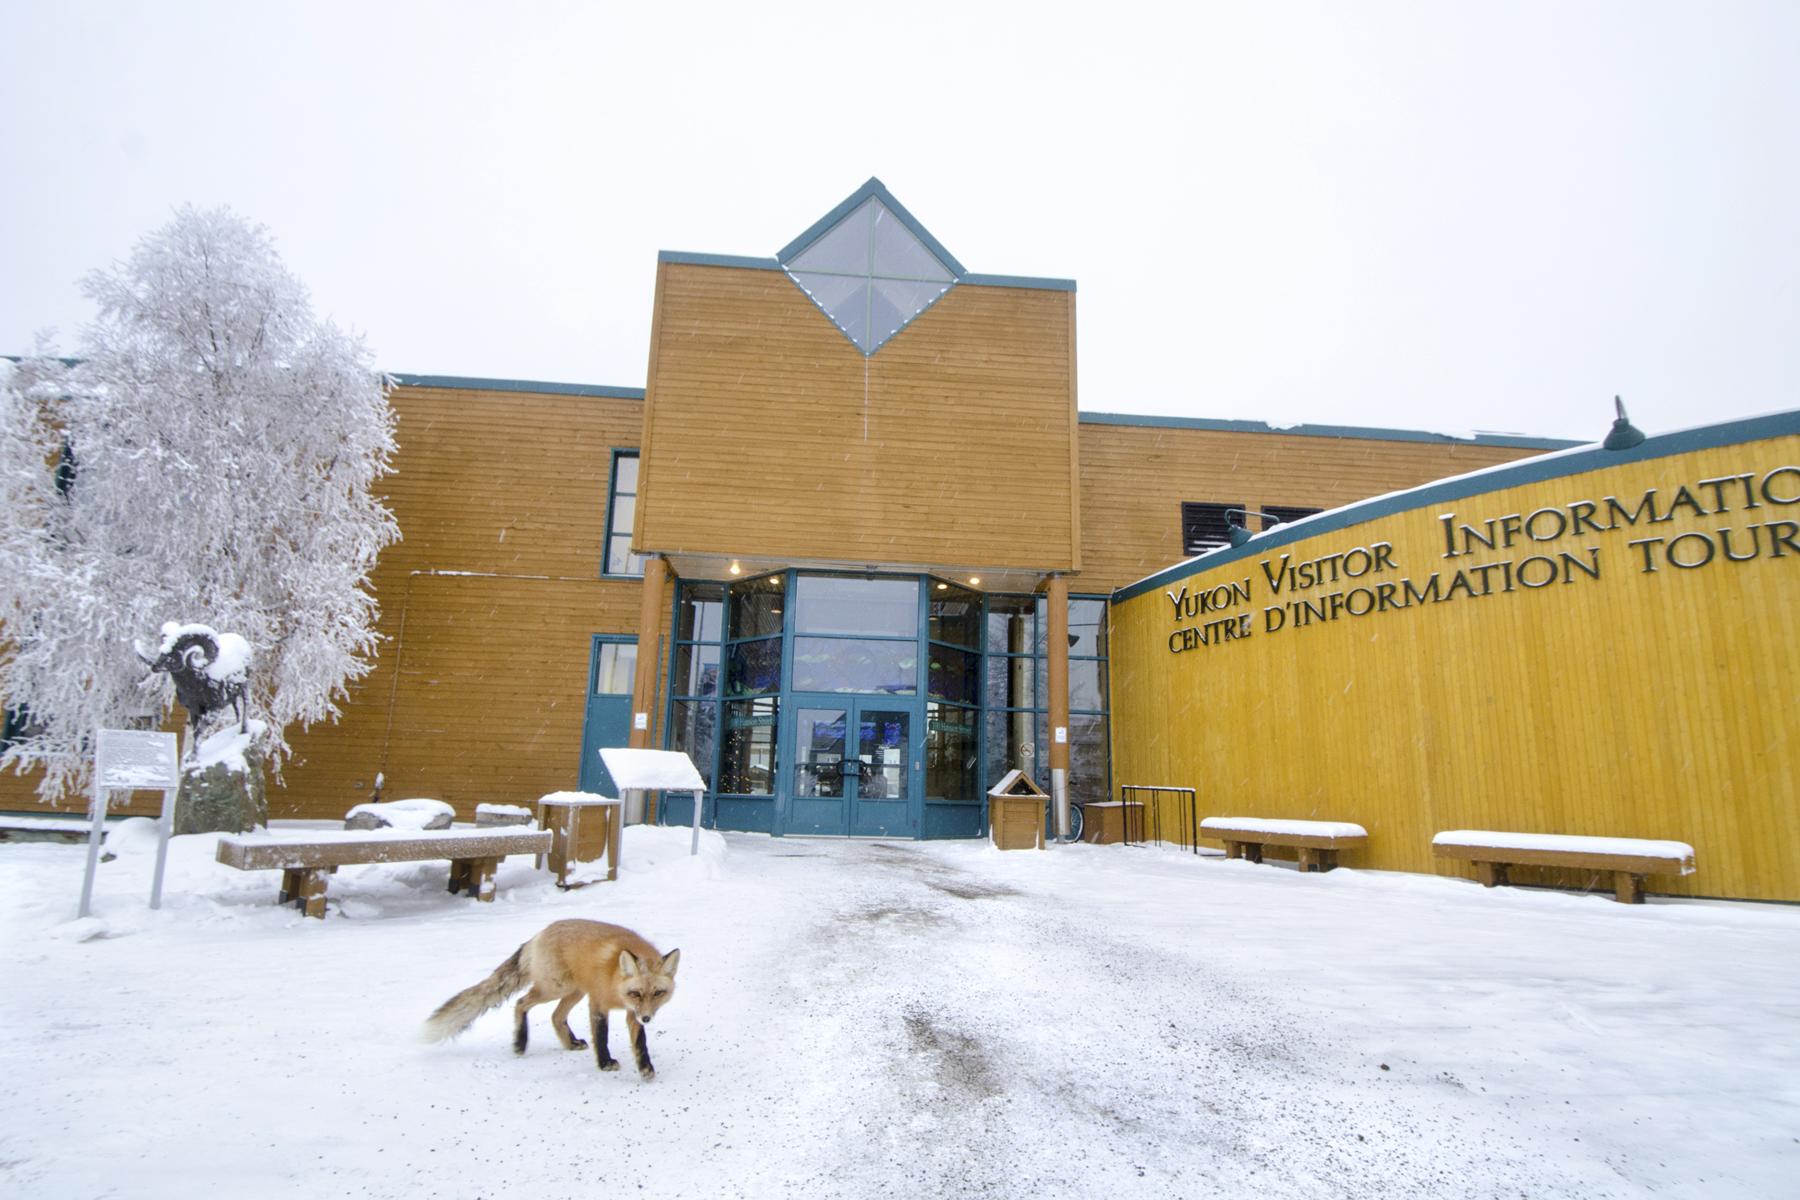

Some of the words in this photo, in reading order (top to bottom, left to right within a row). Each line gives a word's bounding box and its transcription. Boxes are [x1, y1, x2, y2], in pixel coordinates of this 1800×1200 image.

[1167, 577, 1251, 621] YUKON
[1260, 541, 1398, 594] VISITOR
[1168, 613, 1252, 653] CENTRE
[1264, 547, 1600, 633] D'INFORMATION
[1628, 520, 1800, 573] TOUR
